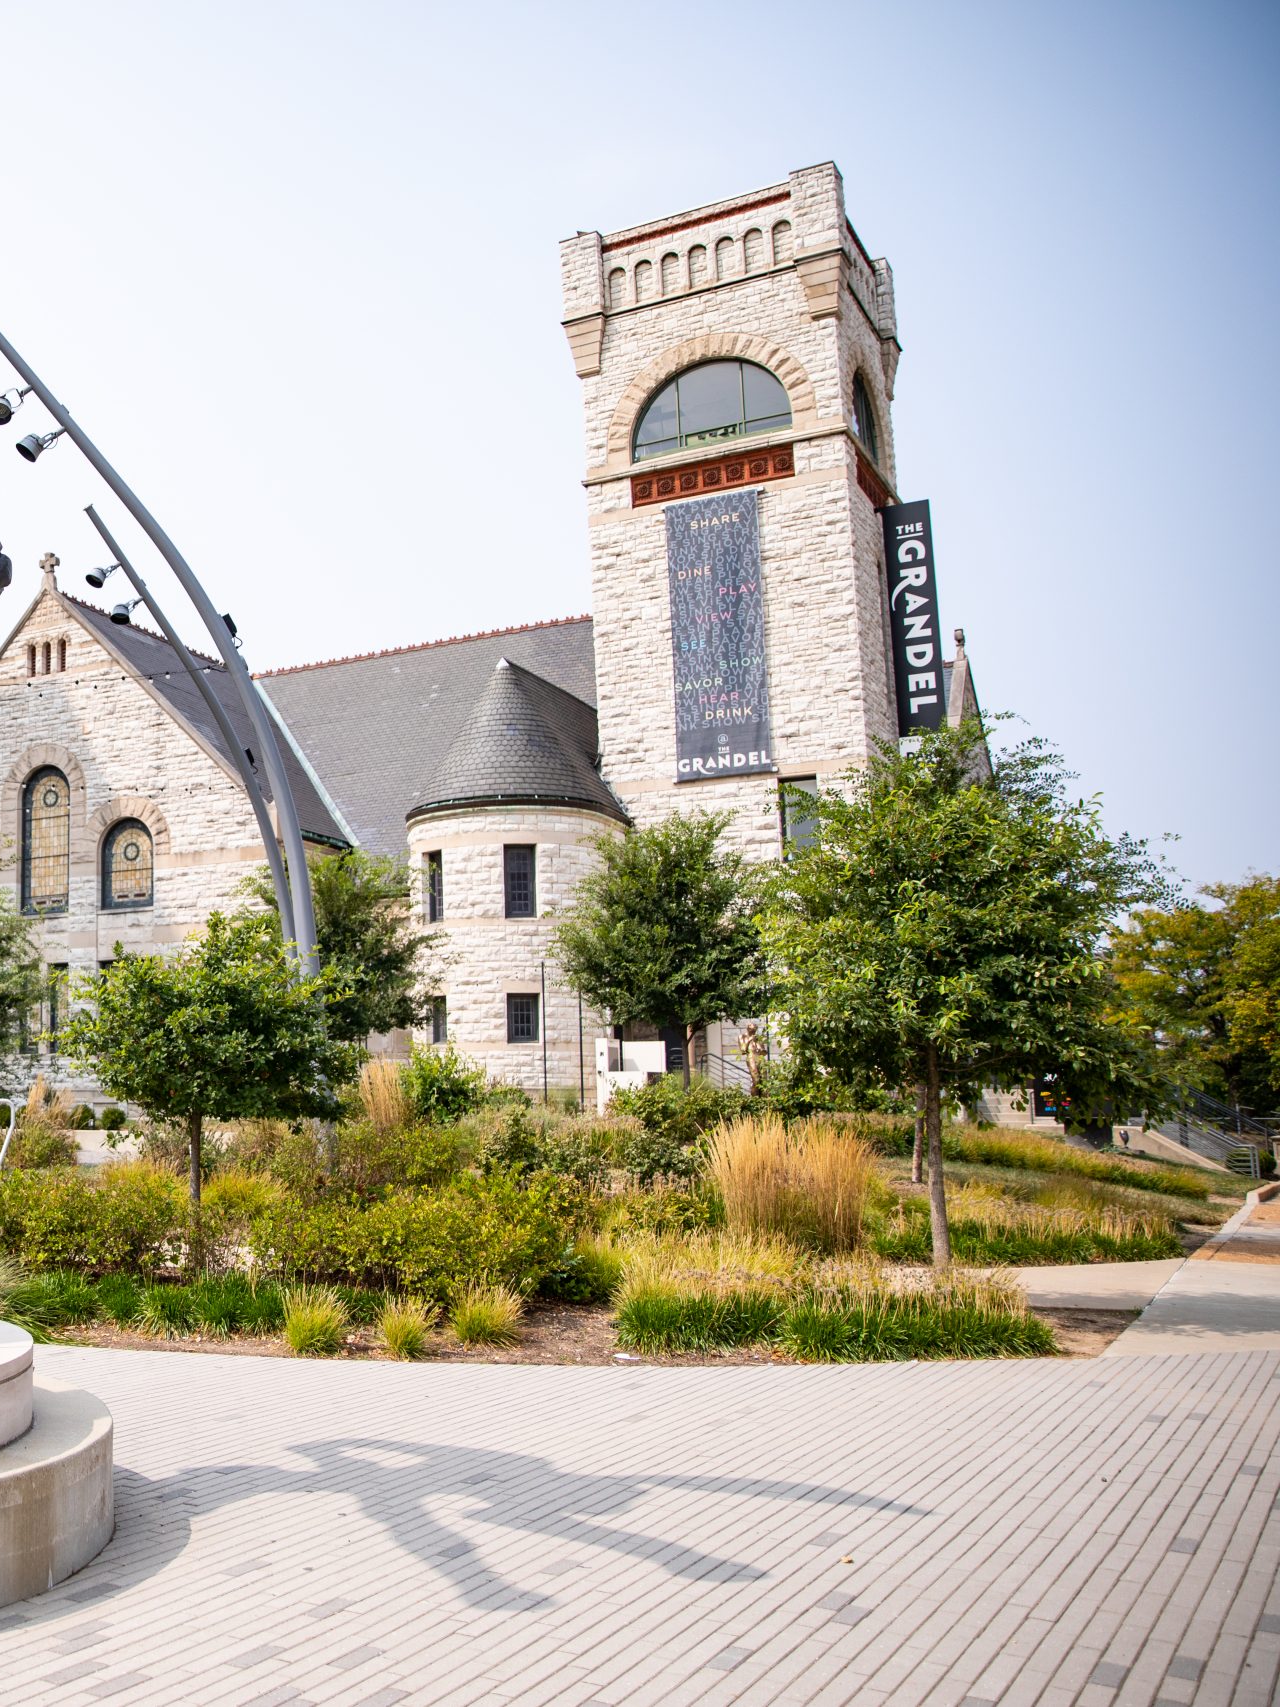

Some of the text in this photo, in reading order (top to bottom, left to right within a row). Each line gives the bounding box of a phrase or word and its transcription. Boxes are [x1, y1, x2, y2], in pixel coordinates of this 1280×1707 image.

[674, 502, 754, 524] HEAR PLAY
[691, 499, 726, 513] PLAY
[690, 512, 739, 529] SHARE
[675, 519, 750, 540] SING PLAY
[896, 522, 923, 535] THE
[682, 533, 716, 546] SING
[703, 536, 746, 551] SHOW
[695, 553, 737, 568] SHOW
[701, 548, 724, 559] SIP
[678, 565, 710, 579] DINE
[715, 558, 751, 573] SING
[675, 574, 712, 587] HEAR
[718, 566, 754, 580] PLAY
[694, 576, 743, 592] SHARE
[676, 582, 756, 603] HEAR PLAY
[700, 594, 736, 607] VIEW
[679, 599, 755, 618] SING PLAY
[695, 611, 731, 624] VIEW
[687, 620, 721, 633] SING
[712, 624, 748, 638] PLAY
[891, 539, 938, 714] GRANDEL
[681, 630, 761, 651] SEE SAVOR
[697, 641, 746, 656] SHARE
[689, 653, 722, 665] SING
[719, 655, 763, 669] SHOW
[700, 666, 744, 680] SHOW
[674, 671, 762, 692] SAVOR DINE
[683, 680, 760, 698] VIEW PLAY
[699, 691, 739, 704] HEAR
[691, 701, 725, 713] SING
[705, 705, 752, 720] DRINK
[701, 715, 746, 728] SHOW
[678, 750, 771, 774] GRANDEL
